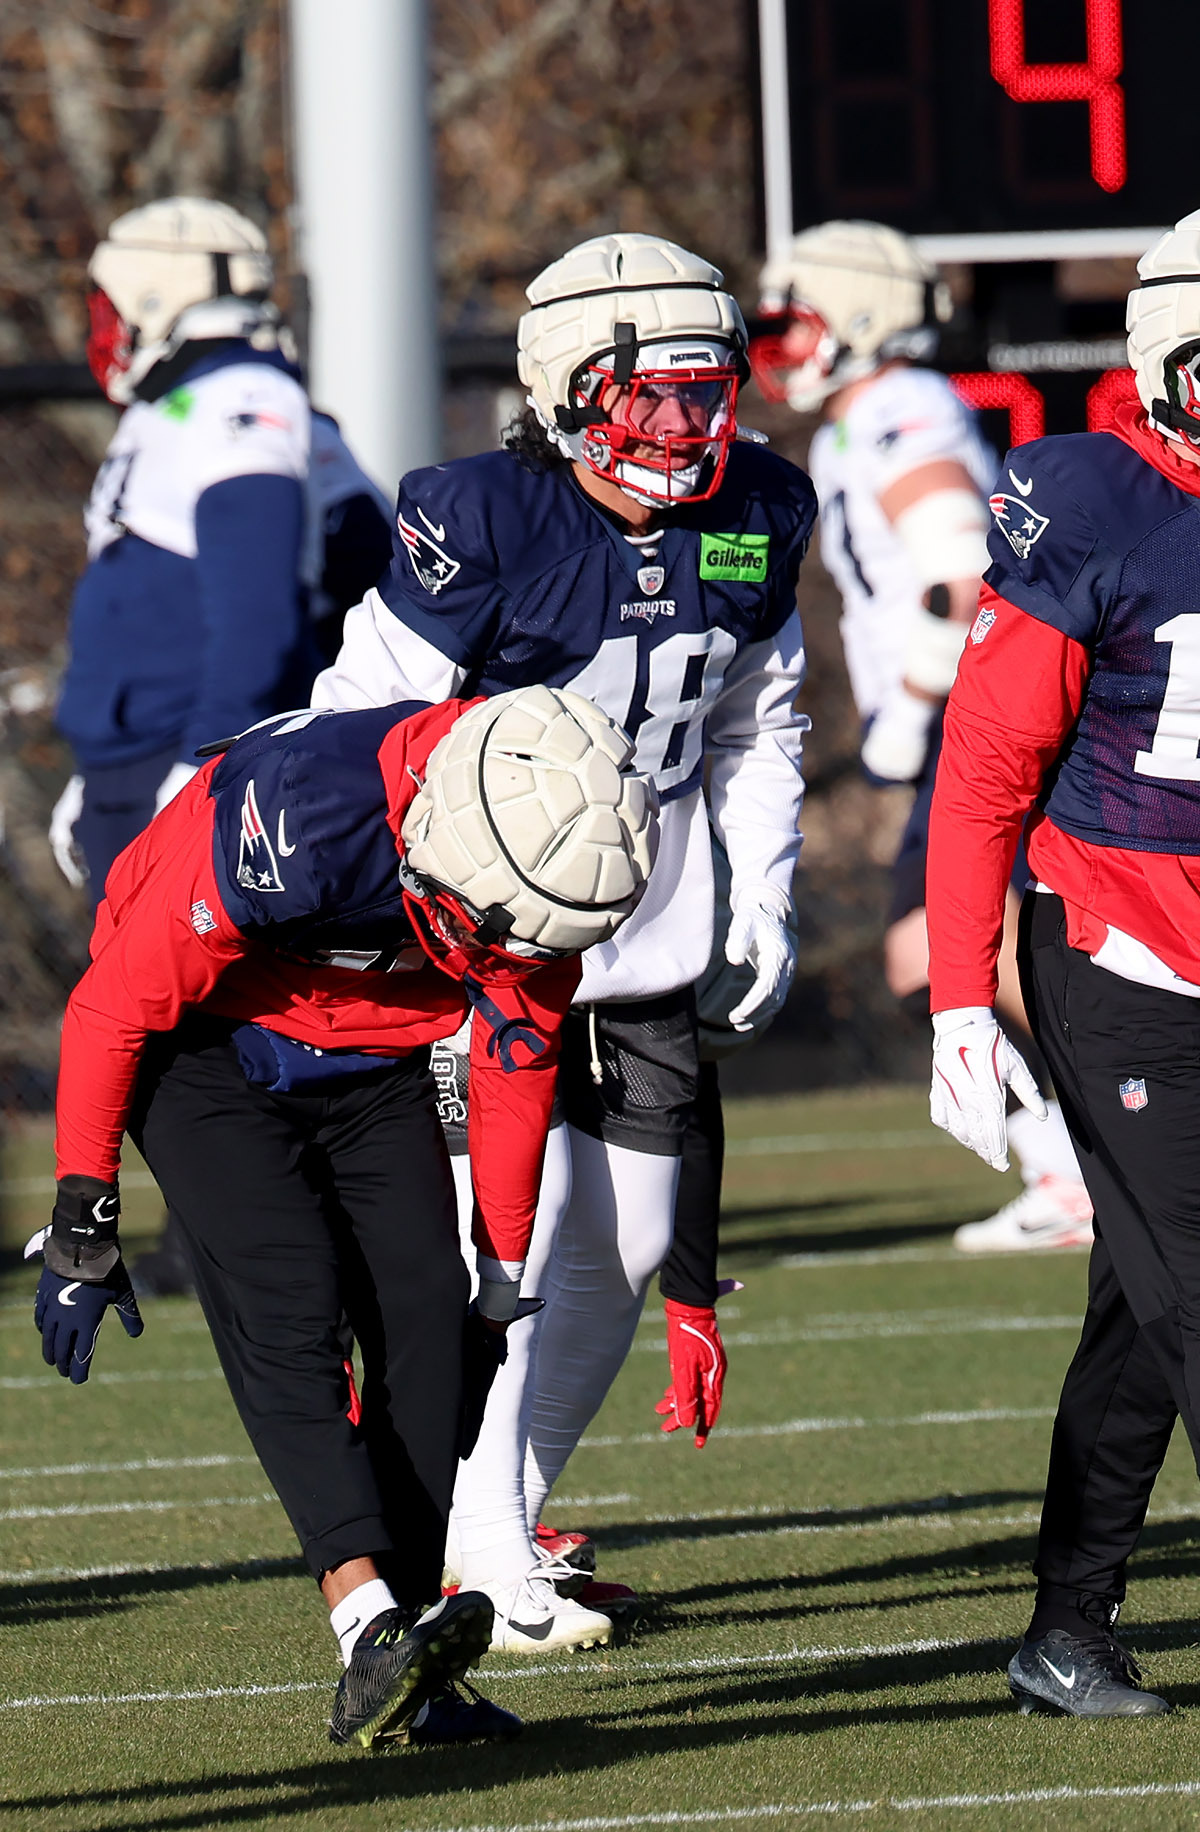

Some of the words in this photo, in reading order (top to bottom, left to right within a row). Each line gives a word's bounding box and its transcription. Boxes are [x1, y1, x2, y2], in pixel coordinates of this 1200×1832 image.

[705, 547, 764, 569] Gillette
[620, 600, 677, 623] PATRIOTS
[563, 626, 737, 791] 48
[1123, 1091, 1146, 1108] NFL
